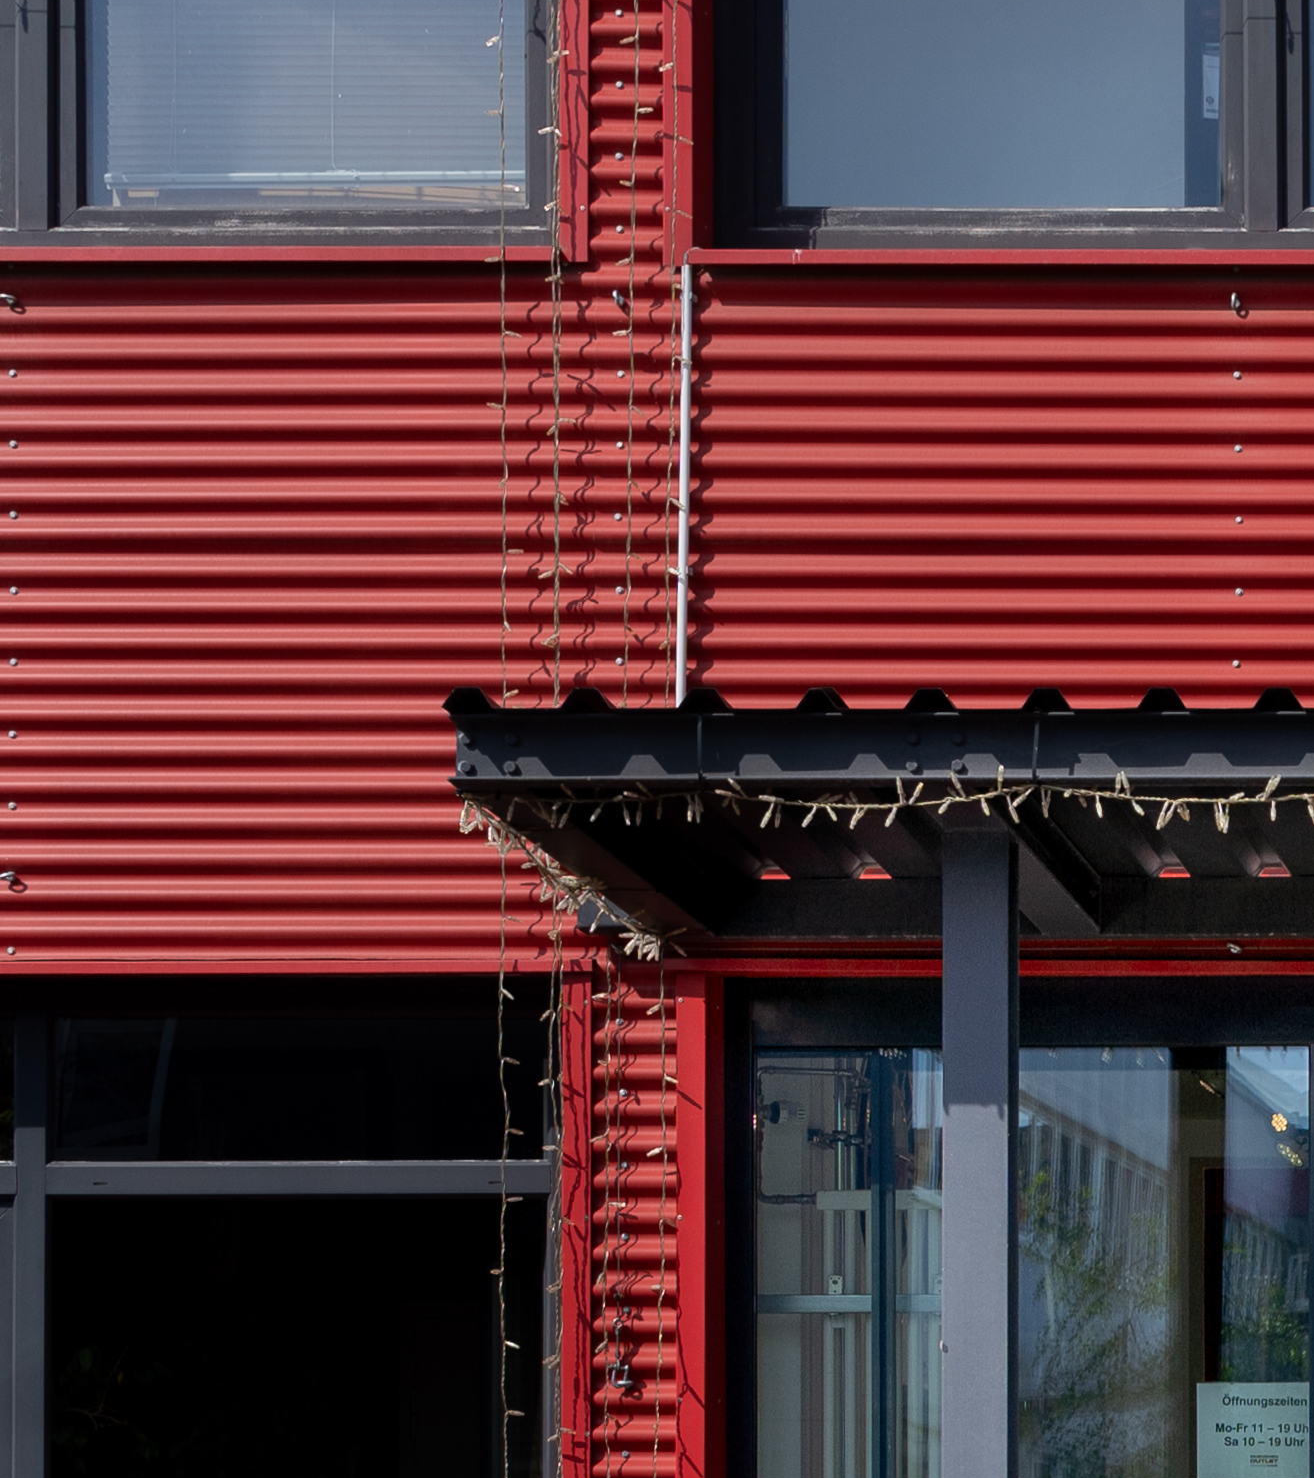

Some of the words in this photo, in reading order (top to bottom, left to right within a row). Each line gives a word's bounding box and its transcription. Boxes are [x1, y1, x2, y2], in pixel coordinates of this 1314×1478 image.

[1222, 1394, 1307, 1407] Öffnungszeiten
[1216, 1423, 1248, 1433] Mo-Fr
[1252, 1424, 1263, 1433] 11
[1278, 1424, 1290, 1433] 19
[1294, 1424, 1309, 1433] Uh
[1224, 1437, 1238, 1446] Sa
[1243, 1438, 1255, 1446] 10
[1269, 1438, 1281, 1446] 19
[1285, 1437, 1304, 1447] Uhr
